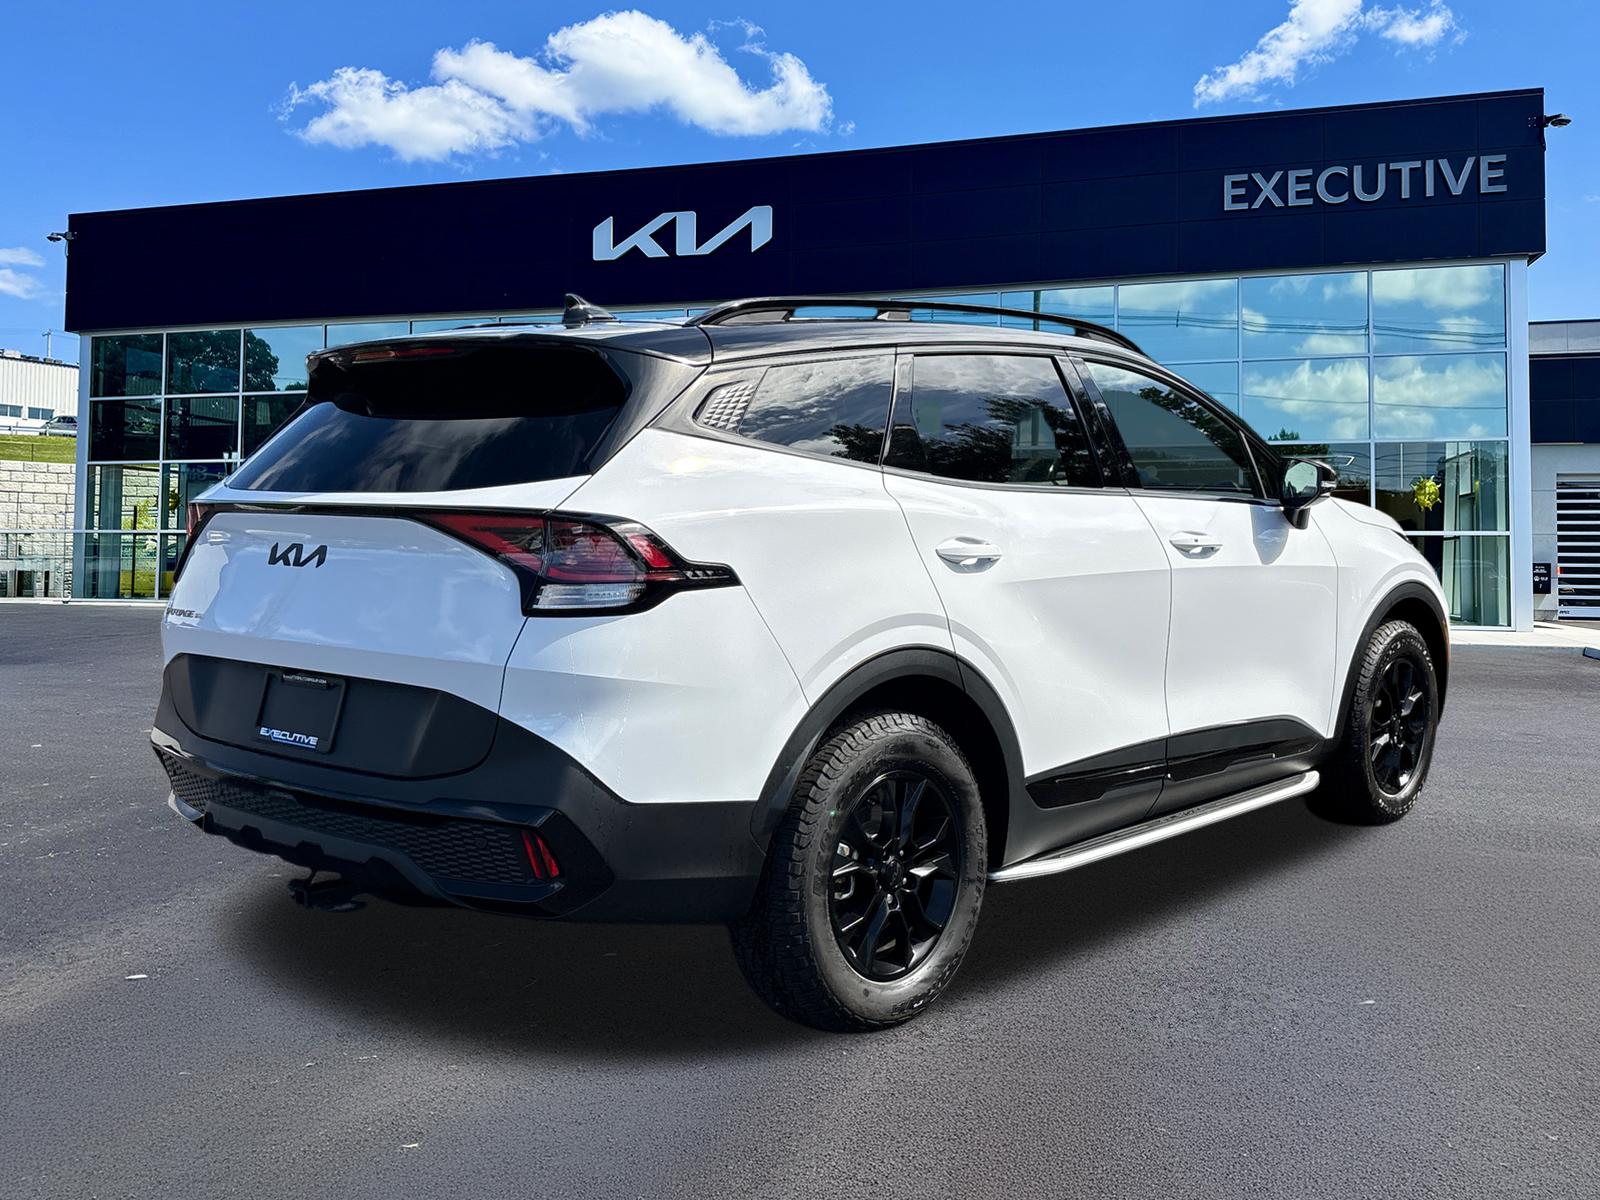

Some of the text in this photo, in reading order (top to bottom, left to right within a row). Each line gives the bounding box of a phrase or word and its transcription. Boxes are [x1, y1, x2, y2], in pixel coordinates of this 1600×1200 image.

[1224, 154, 1508, 211] EXECUTIVE
[593, 205, 772, 261] KIA
[267, 542, 328, 568] KIA
[260, 727, 319, 746] EXECUTIVE
